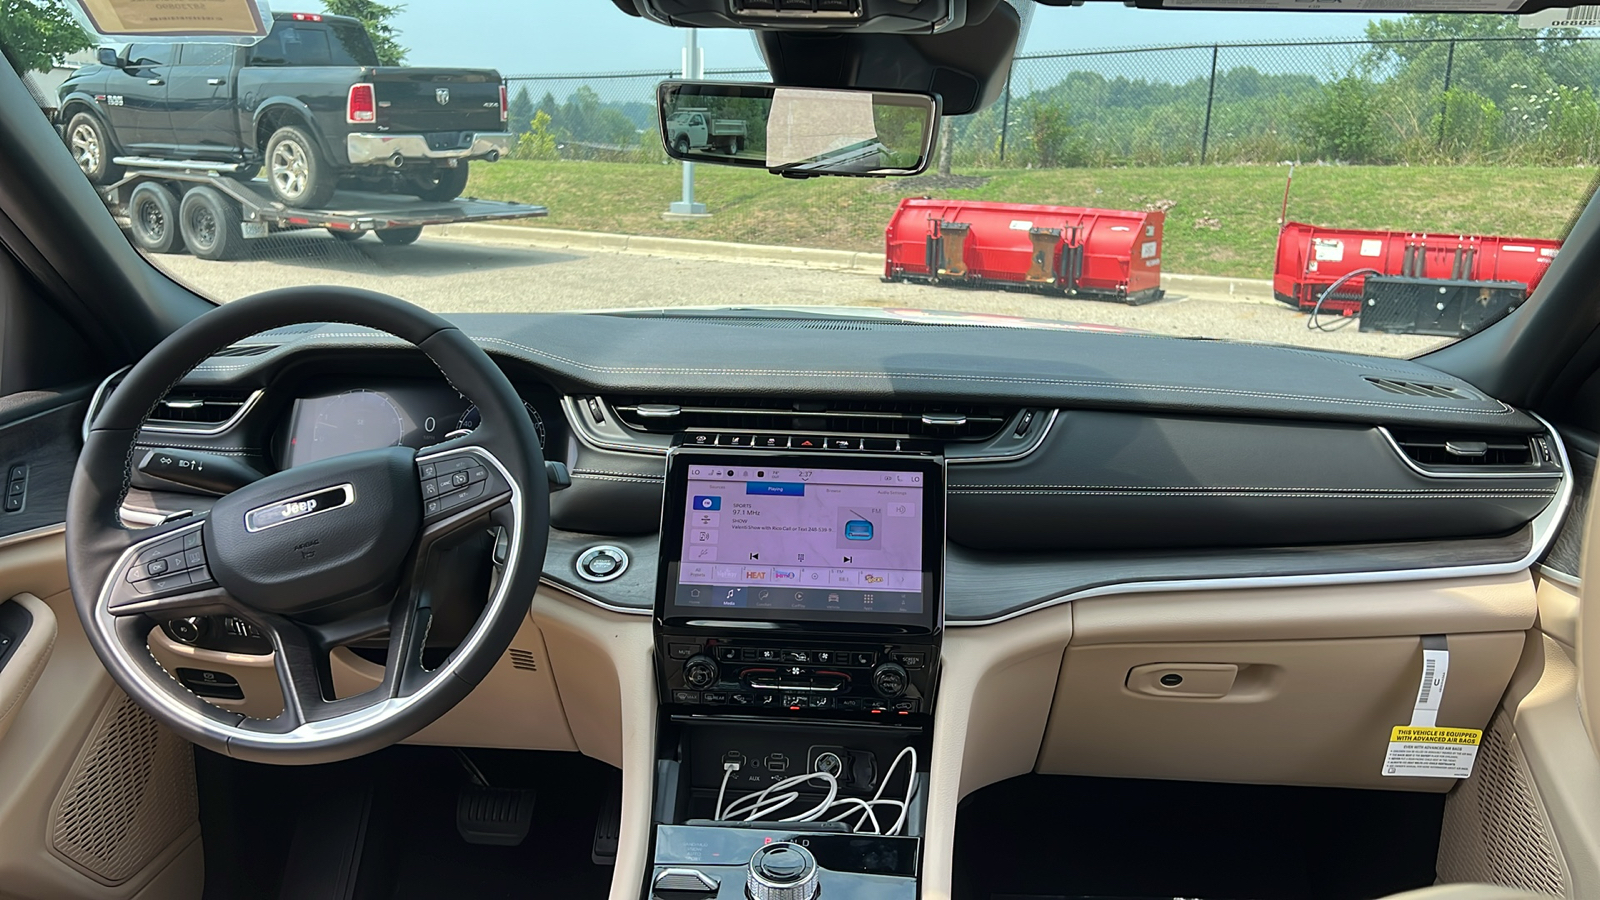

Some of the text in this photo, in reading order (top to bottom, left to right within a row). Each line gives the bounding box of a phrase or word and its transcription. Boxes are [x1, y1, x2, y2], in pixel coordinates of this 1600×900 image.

[424, 416, 437, 433] 0
[462, 420, 473, 428] 40
[281, 499, 317, 517] Jeep
[746, 571, 766, 579] HEAT
[764, 837, 772, 845] P
[802, 839, 810, 847] D
